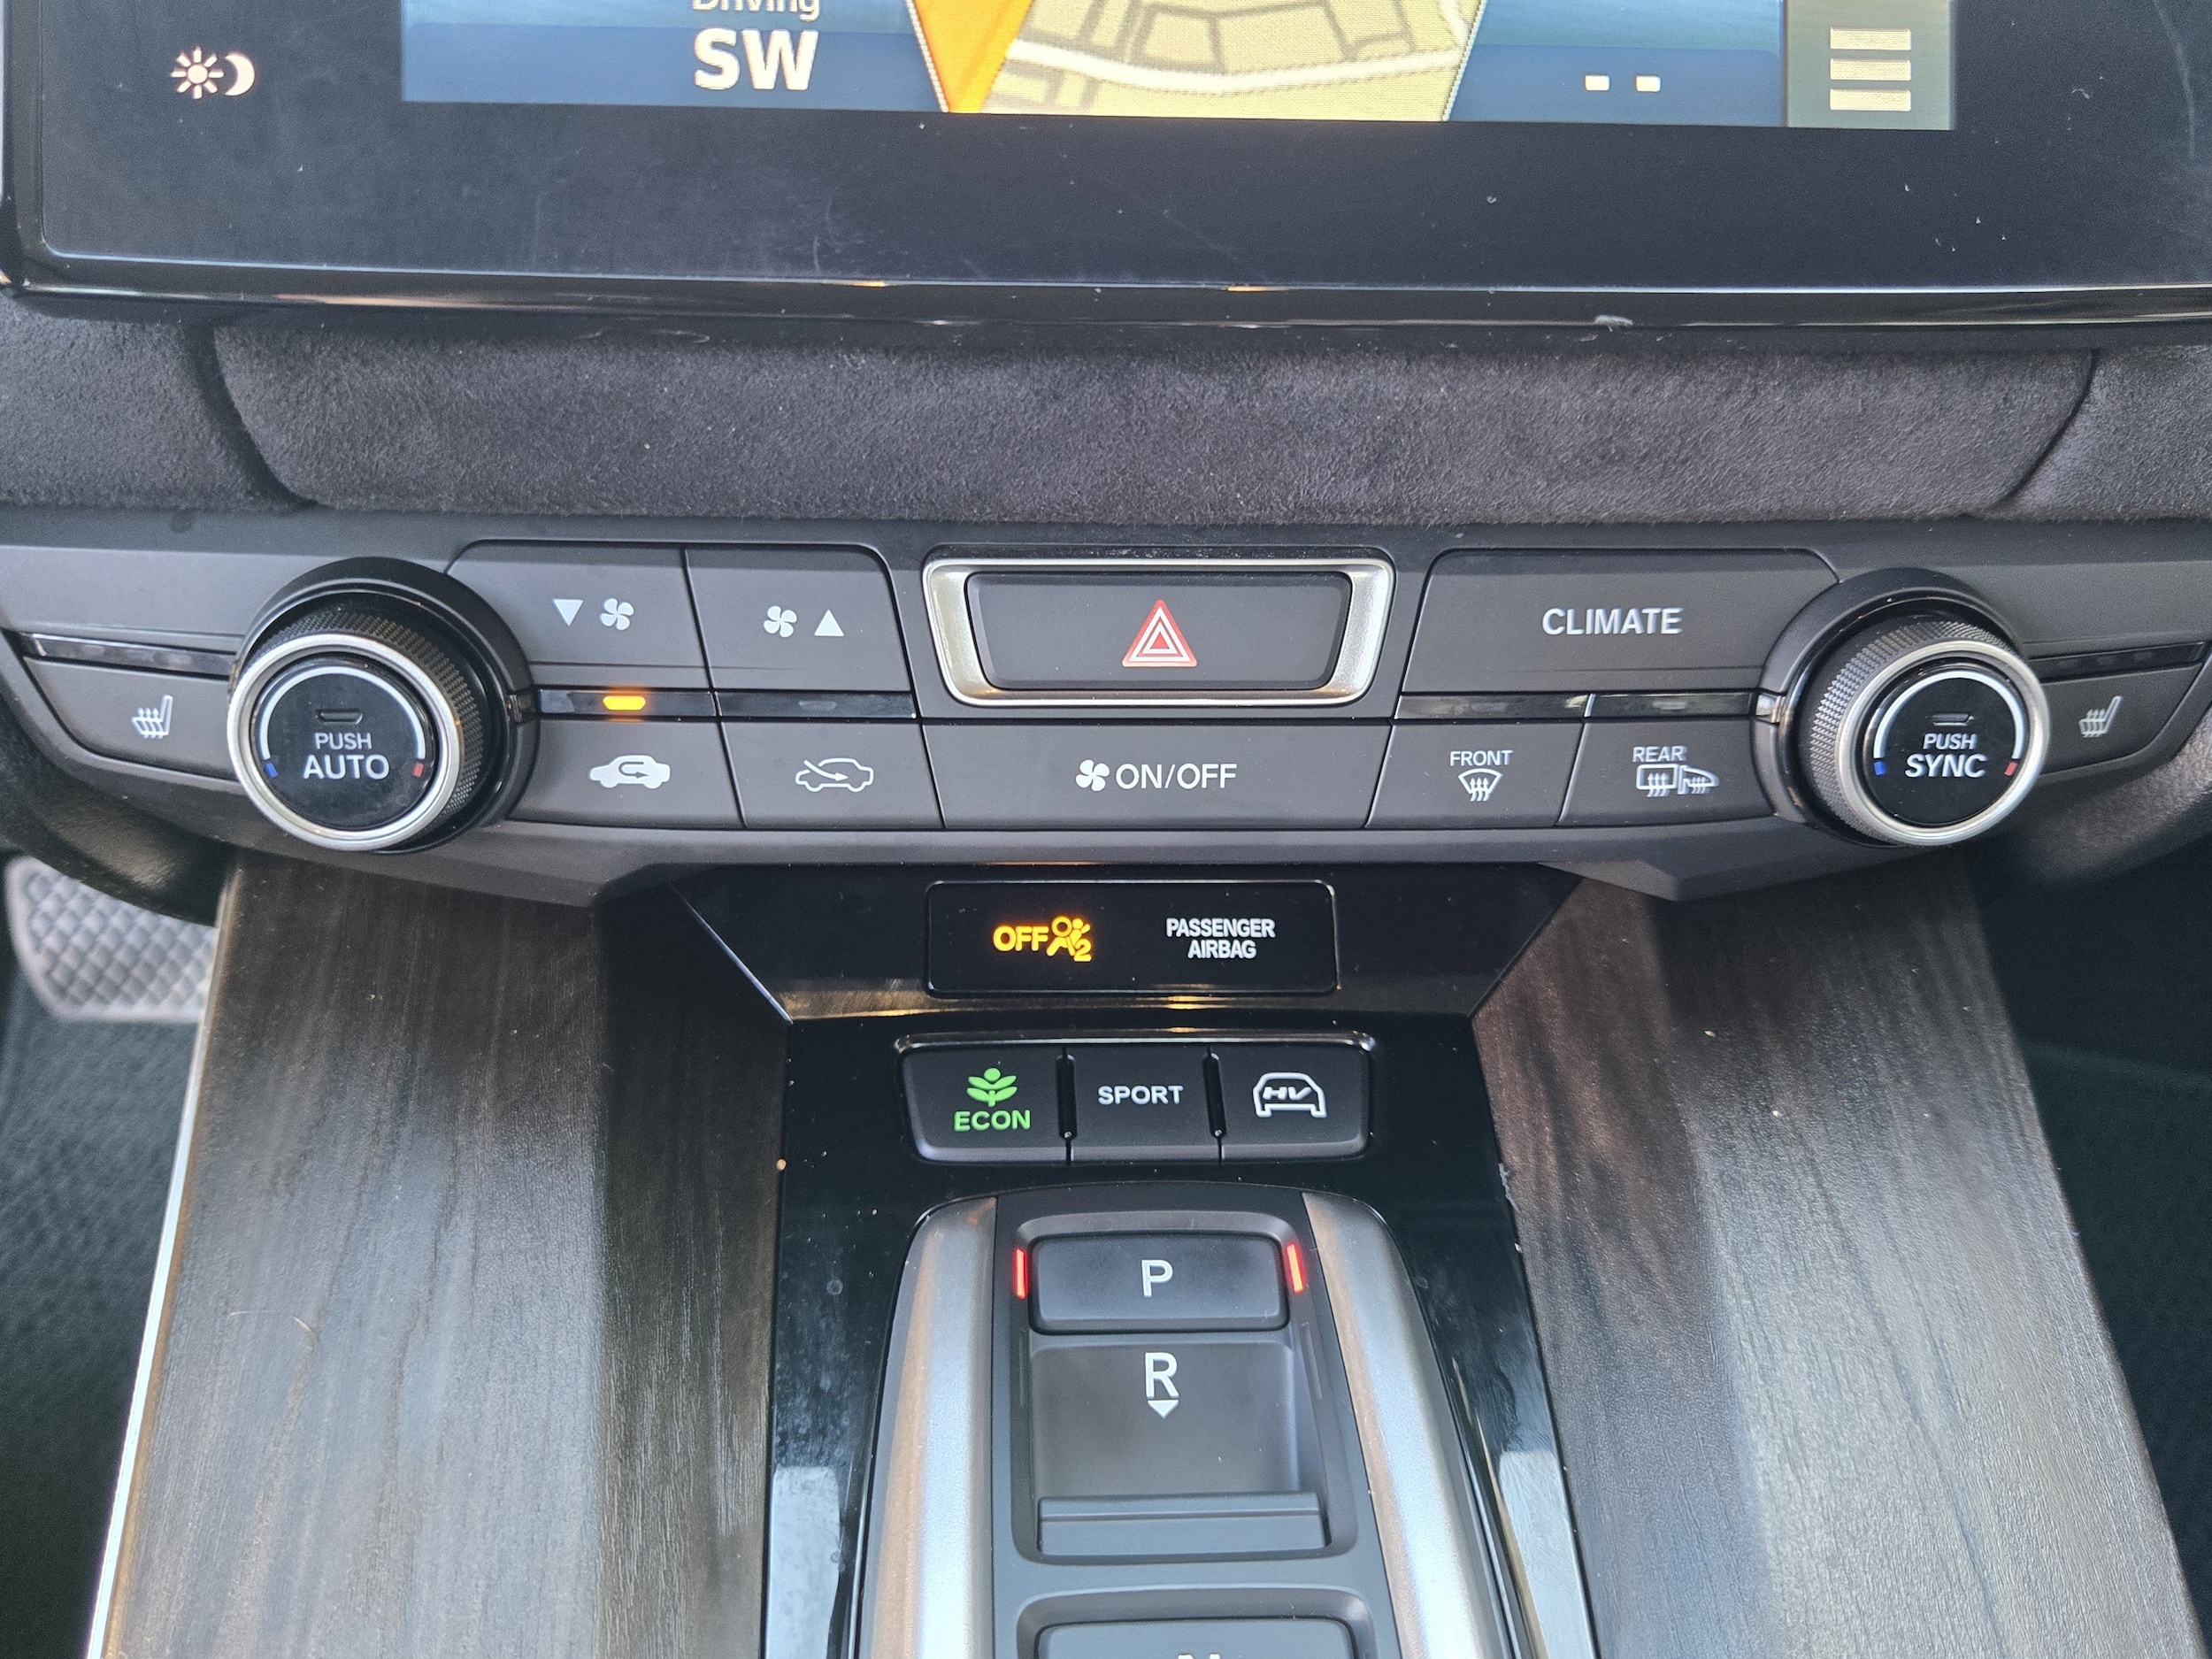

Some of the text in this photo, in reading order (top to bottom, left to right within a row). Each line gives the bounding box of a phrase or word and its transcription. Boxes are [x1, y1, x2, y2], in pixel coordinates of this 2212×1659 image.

[694, 27, 819, 90] SW
[1542, 607, 1683, 636] CLIMATE
[313, 731, 373, 751] PUSH
[1923, 732, 1978, 751] PUSH
[1449, 749, 1513, 769] FRONT
[1632, 745, 1687, 764] REAR
[303, 754, 390, 780] AUTO
[1115, 763, 1238, 790] ON/OFF
[1904, 753, 1987, 779] SYNC
[993, 926, 1049, 951] OFF
[1165, 918, 1276, 939] PASSENGER
[1187, 939, 1257, 960] AIRBAG
[1097, 1085, 1184, 1105] SPORT
[1263, 1087, 1312, 1100] HV
[953, 1110, 1031, 1132] ECON
[1141, 1258, 1174, 1298] P
[1144, 1352, 1179, 1398] R
